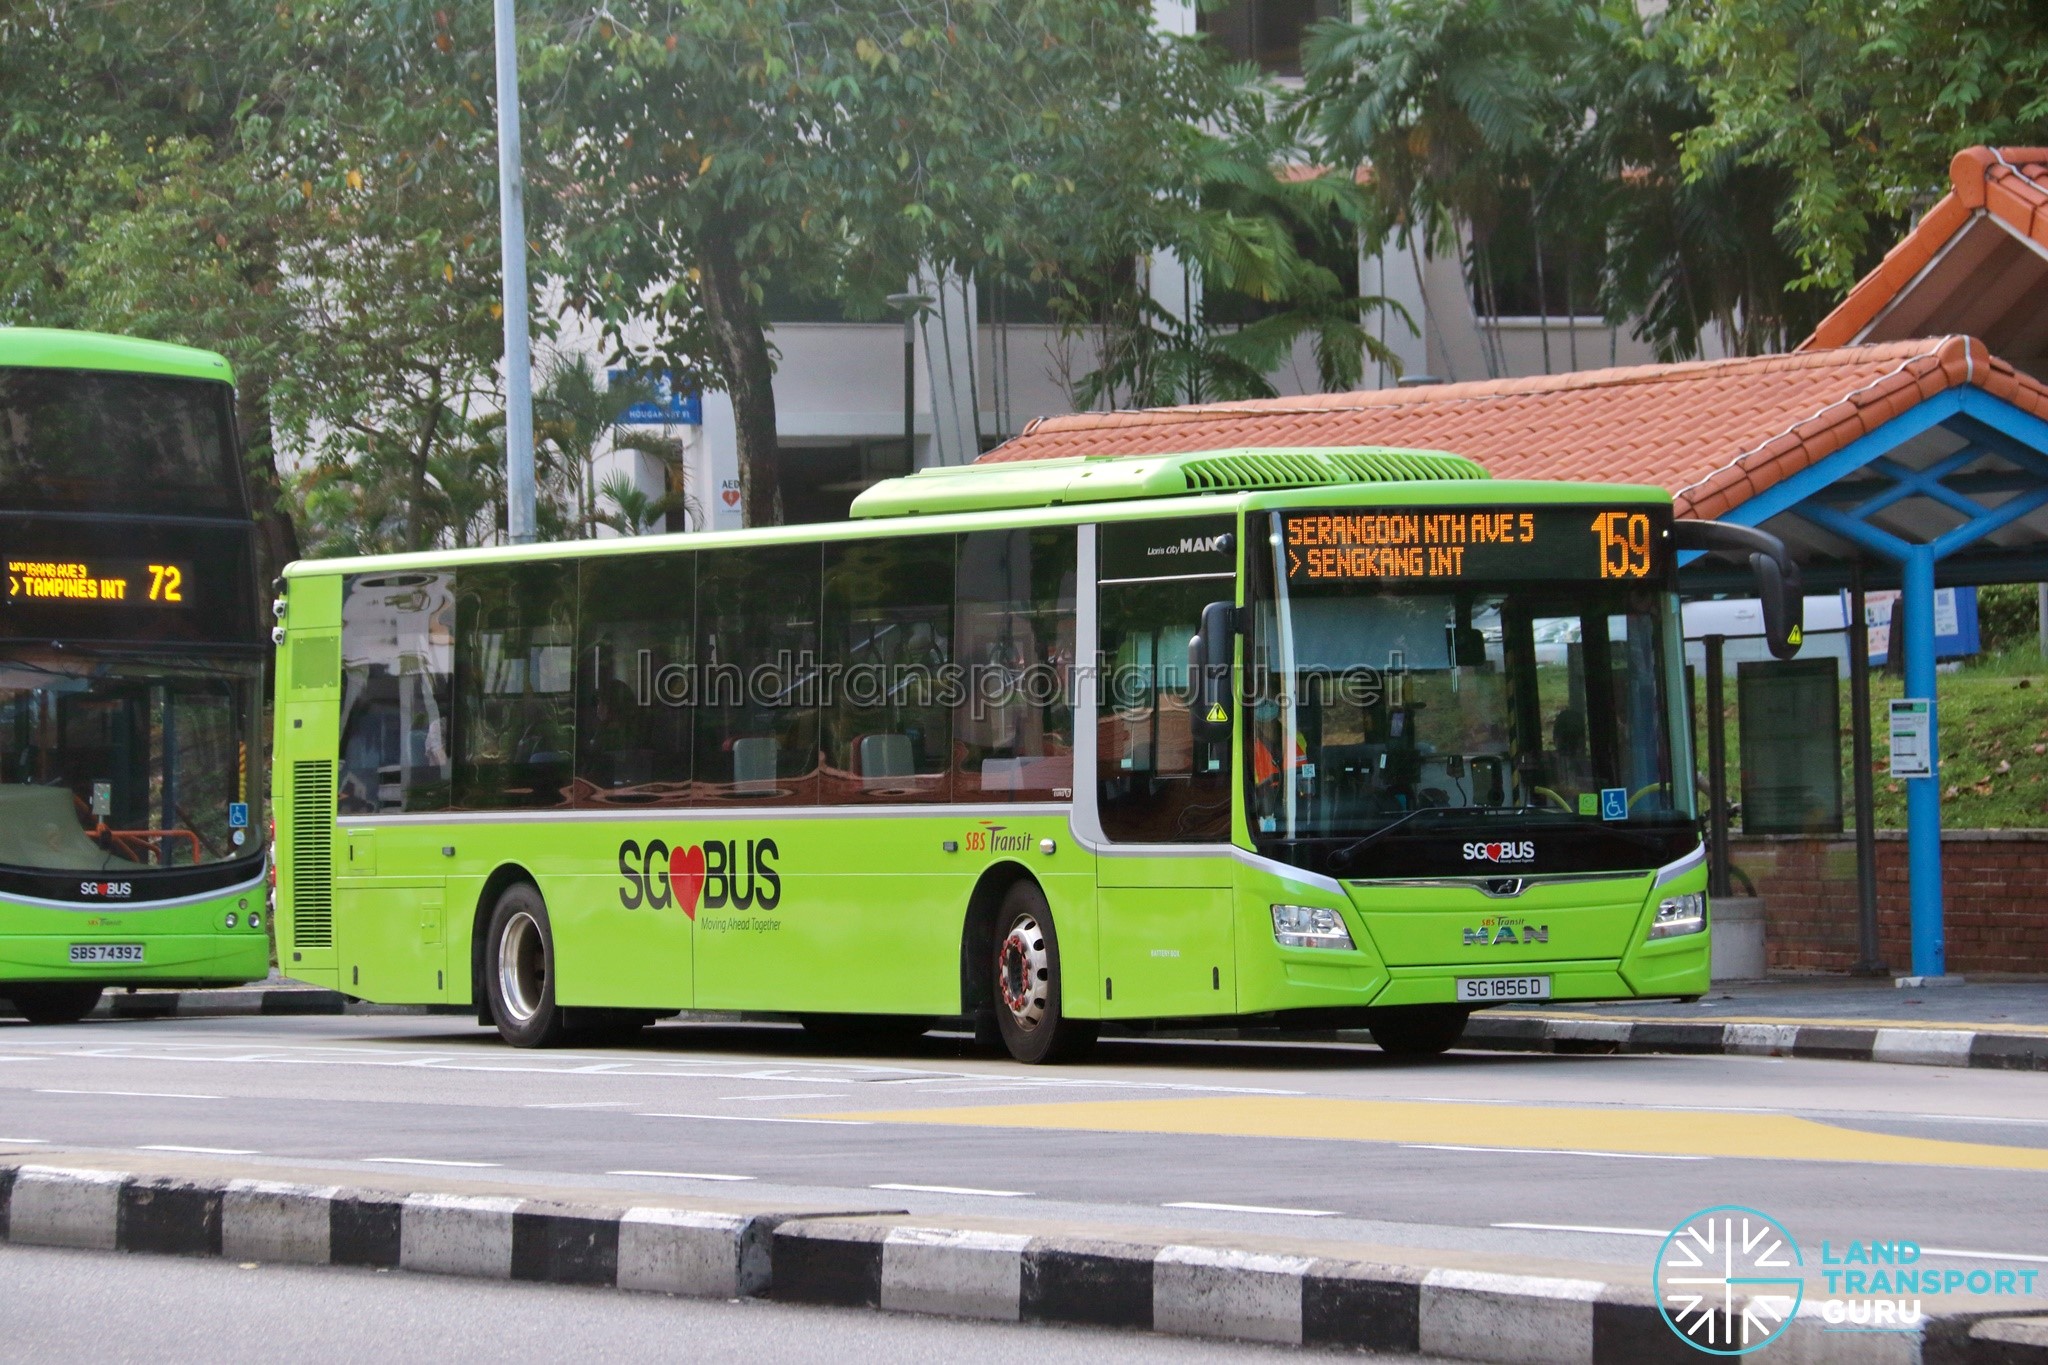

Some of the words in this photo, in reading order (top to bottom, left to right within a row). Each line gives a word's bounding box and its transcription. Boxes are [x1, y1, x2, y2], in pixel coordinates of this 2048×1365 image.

[722, 480, 740, 489] AED
[1288, 515, 1419, 545] SERANGOON
[1424, 514, 1465, 543] NTH
[1471, 513, 1514, 543] AVE
[1519, 513, 1534, 542] 5
[1166, 545, 1180, 555] City
[1180, 536, 1219, 553] MAN
[1591, 512, 1650, 578] 159
[1307, 547, 1424, 577] SENGKANG
[1429, 547, 1464, 576] INT
[22, 576, 98, 598] TAMPINES
[100, 579, 127, 599] INT
[148, 565, 181, 601] 72
[965, 831, 986, 851] SBS
[985, 826, 1034, 855] Transit
[701, 916, 726, 933] Moving
[727, 917, 750, 931] Ahead
[752, 917, 781, 934] Together
[1462, 925, 1549, 946] MAN
